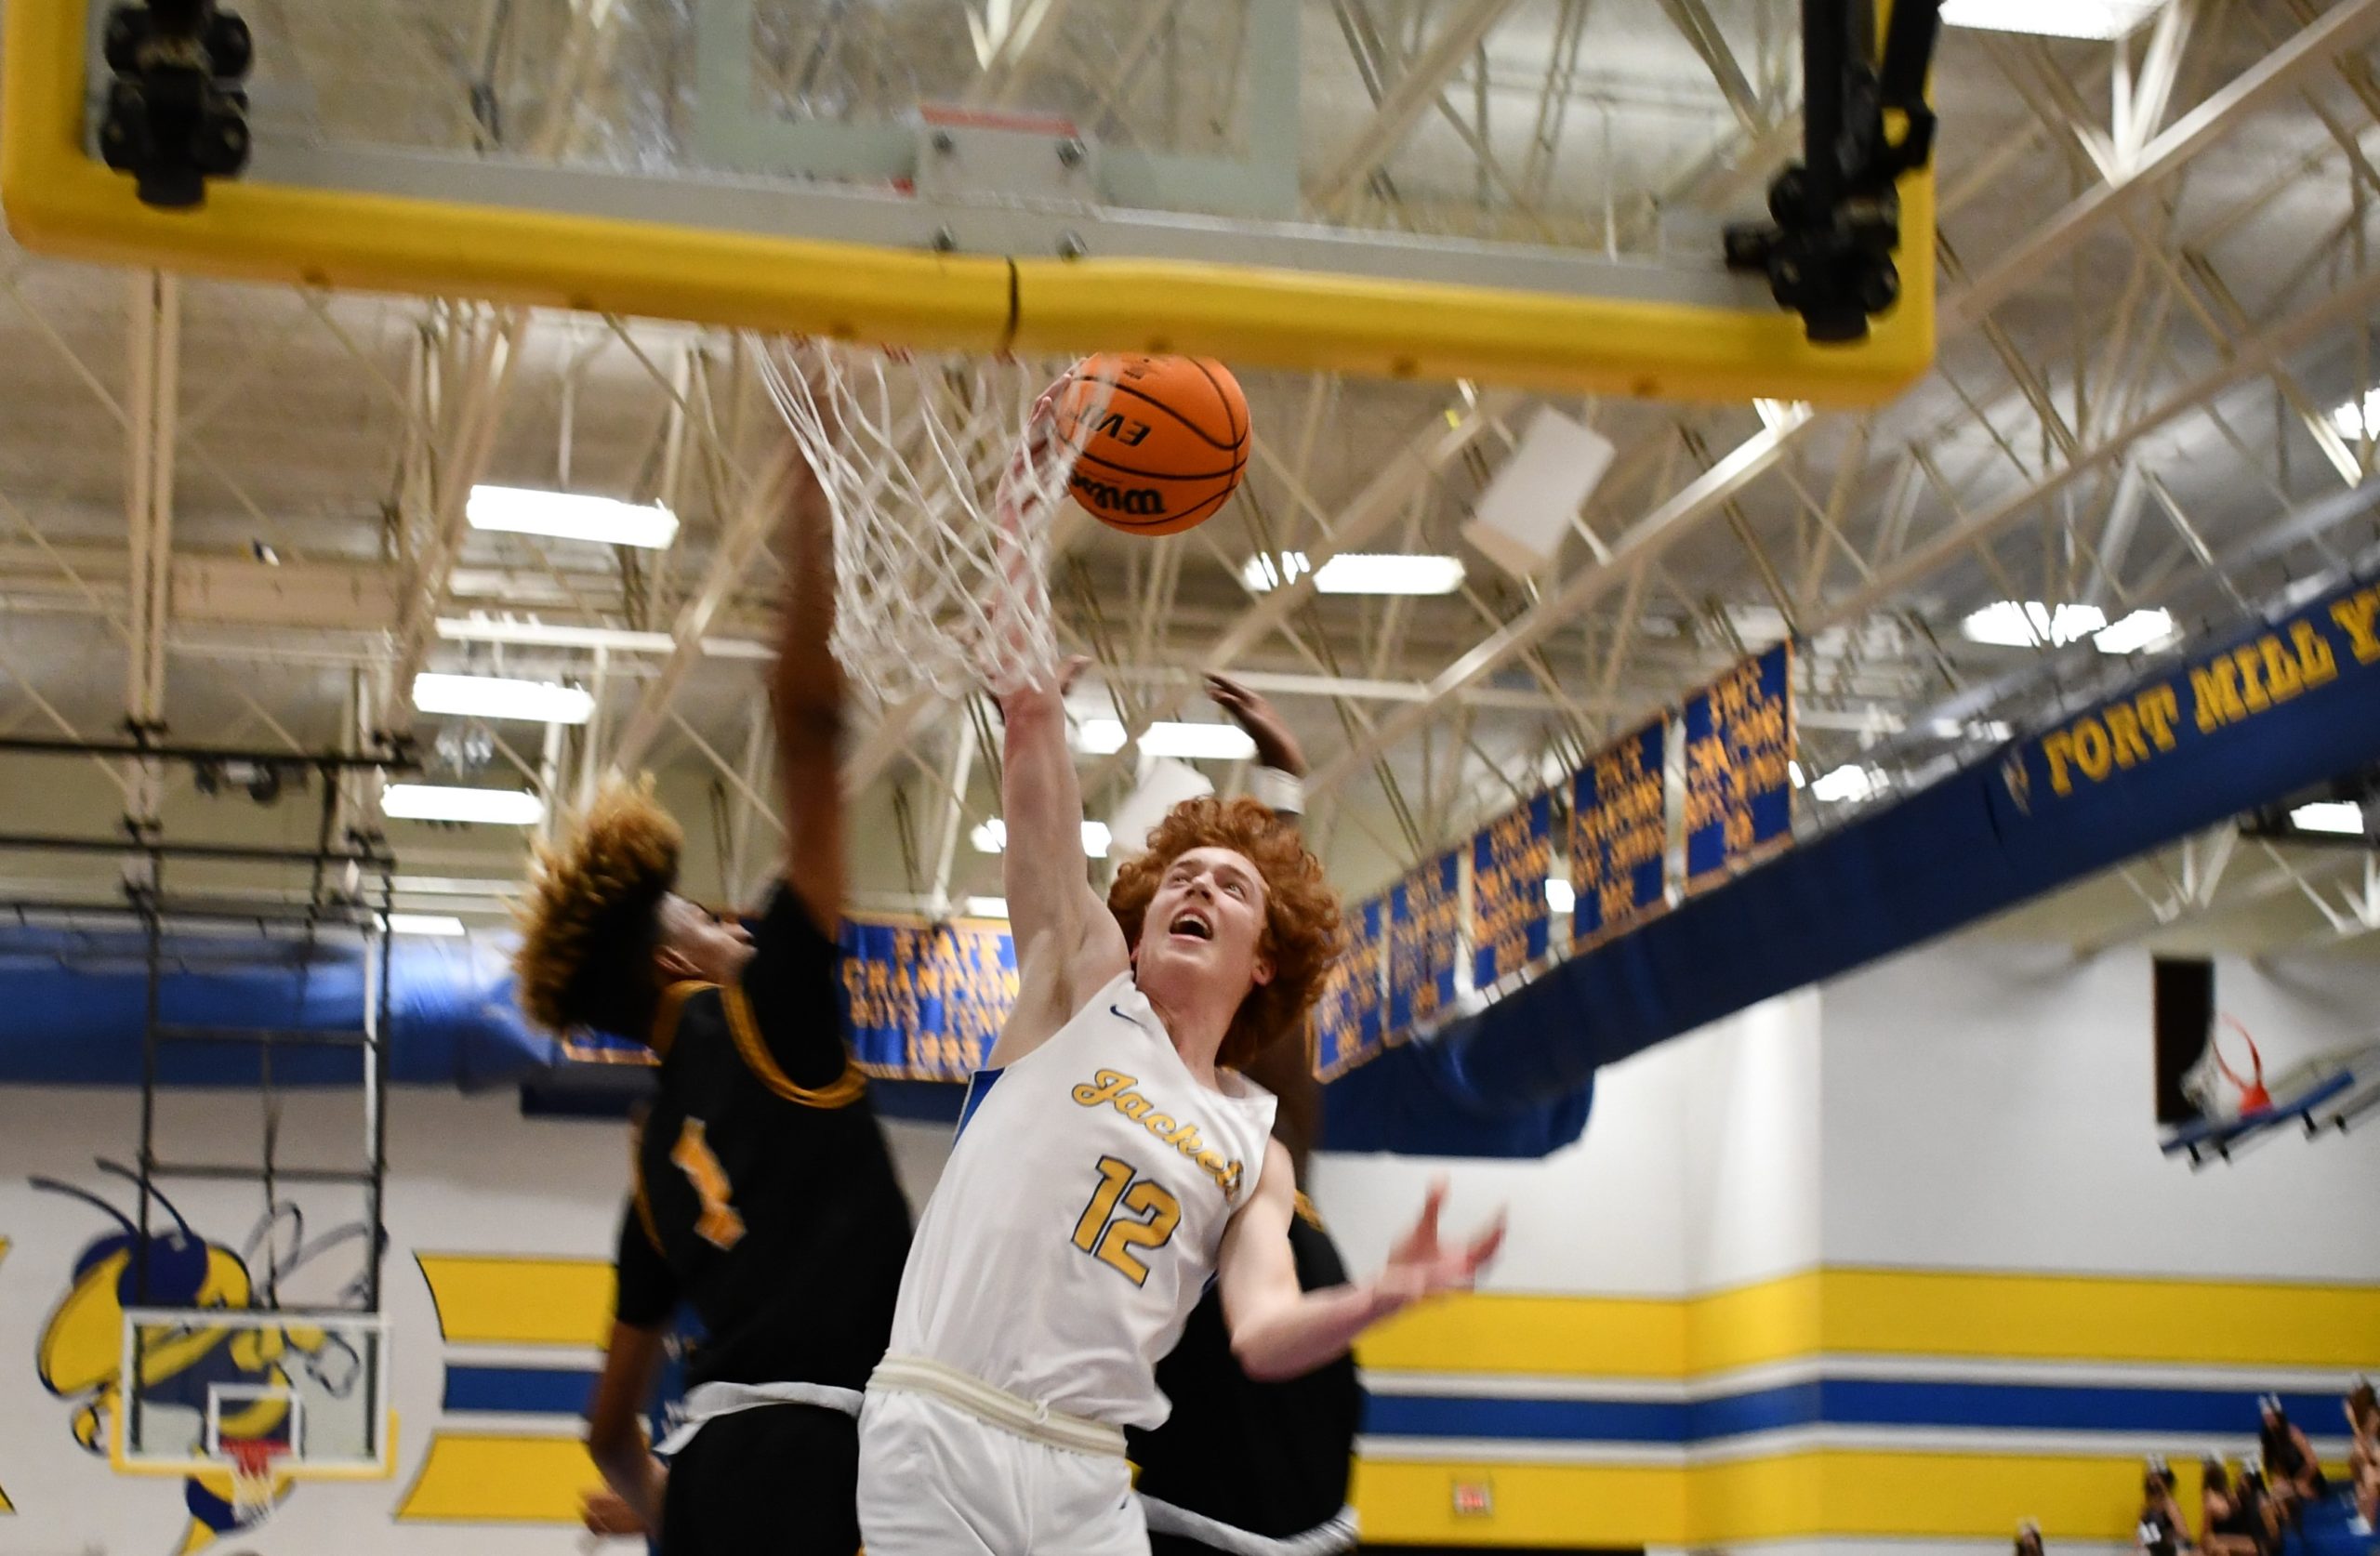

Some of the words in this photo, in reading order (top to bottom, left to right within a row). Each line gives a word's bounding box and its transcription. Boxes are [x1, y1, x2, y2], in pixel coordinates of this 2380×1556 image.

[2042, 682, 2180, 798] FORT
[2189, 619, 2339, 734] MILL
[1071, 1154, 1182, 1288] 12
